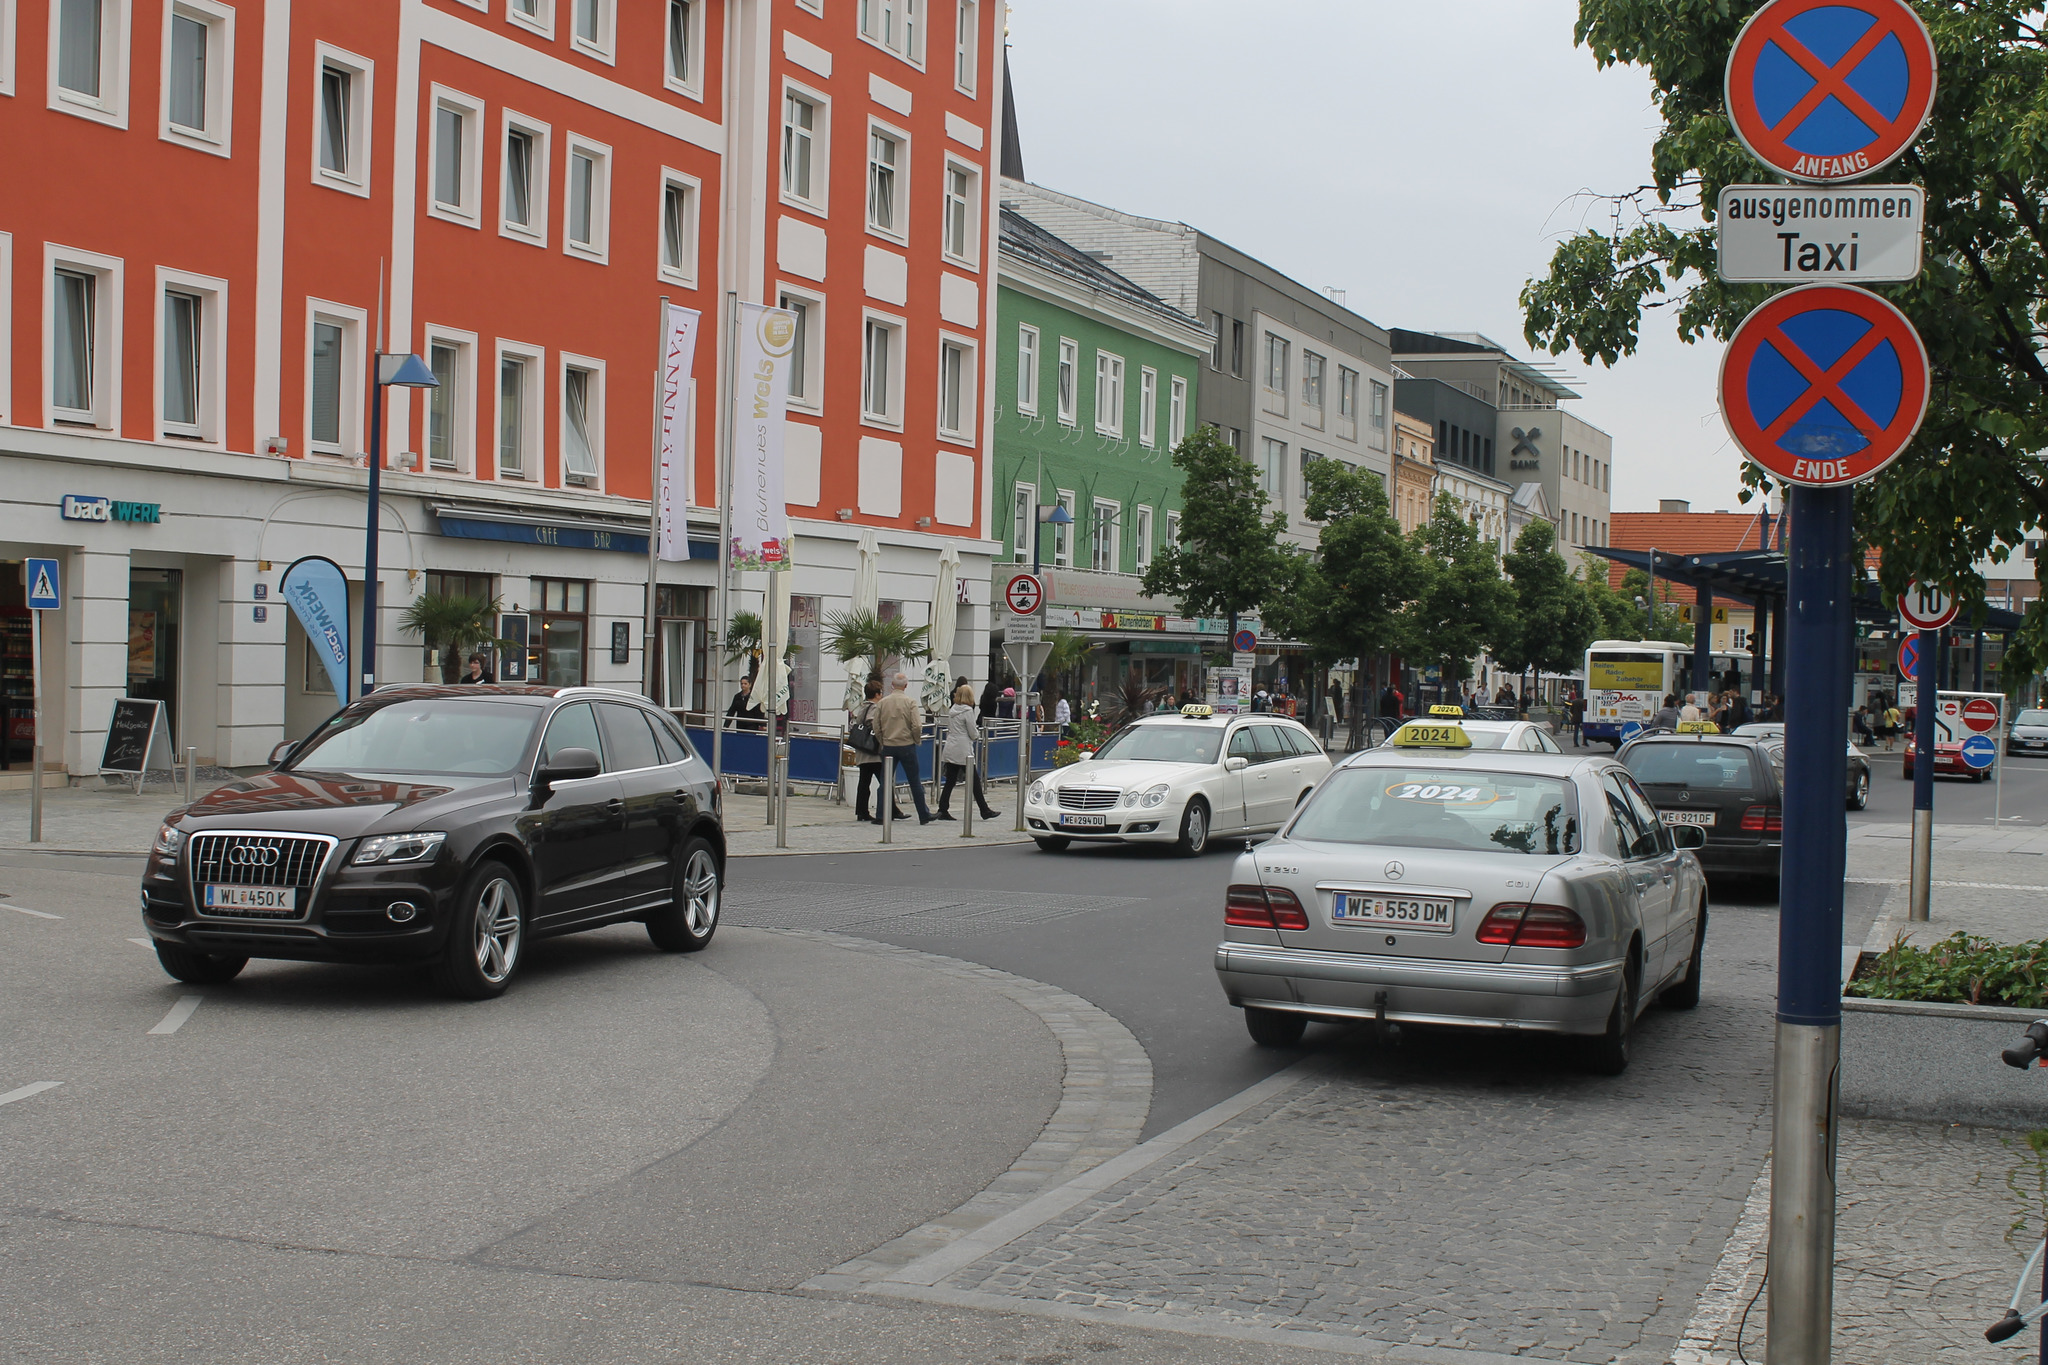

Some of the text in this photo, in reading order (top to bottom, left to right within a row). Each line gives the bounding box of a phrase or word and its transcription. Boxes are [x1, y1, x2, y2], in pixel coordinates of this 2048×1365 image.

[1792, 152, 1869, 176] ANFANG
[1728, 195, 1912, 227] ausgenommen
[1777, 232, 1860, 272] Taxi
[753, 359, 774, 419] Wels
[1510, 460, 1540, 470] BANK
[1792, 459, 1851, 480] ENDE
[535, 526, 611, 549] CAFE BAR
[1918, 585, 1942, 614] 10
[1683, 607, 1691, 621] 4
[1715, 608, 1724, 621] 4
[1858, 626, 1865, 636] 3
[1900, 685, 1917, 693] ausgen
[1909, 694, 1917, 704] Ta
[1184, 705, 1208, 713] TAXI
[1411, 728, 1450, 741] 2024
[1397, 785, 1481, 801] 2024
[1064, 816, 1074, 824] WE
[1078, 816, 1092, 825] 294
[1661, 812, 1712, 823] WE 921 DF
[1505, 879, 1530, 888] CDI
[221, 888, 286, 906] WL 450 K
[1348, 897, 1447, 922] WE 553 DM
